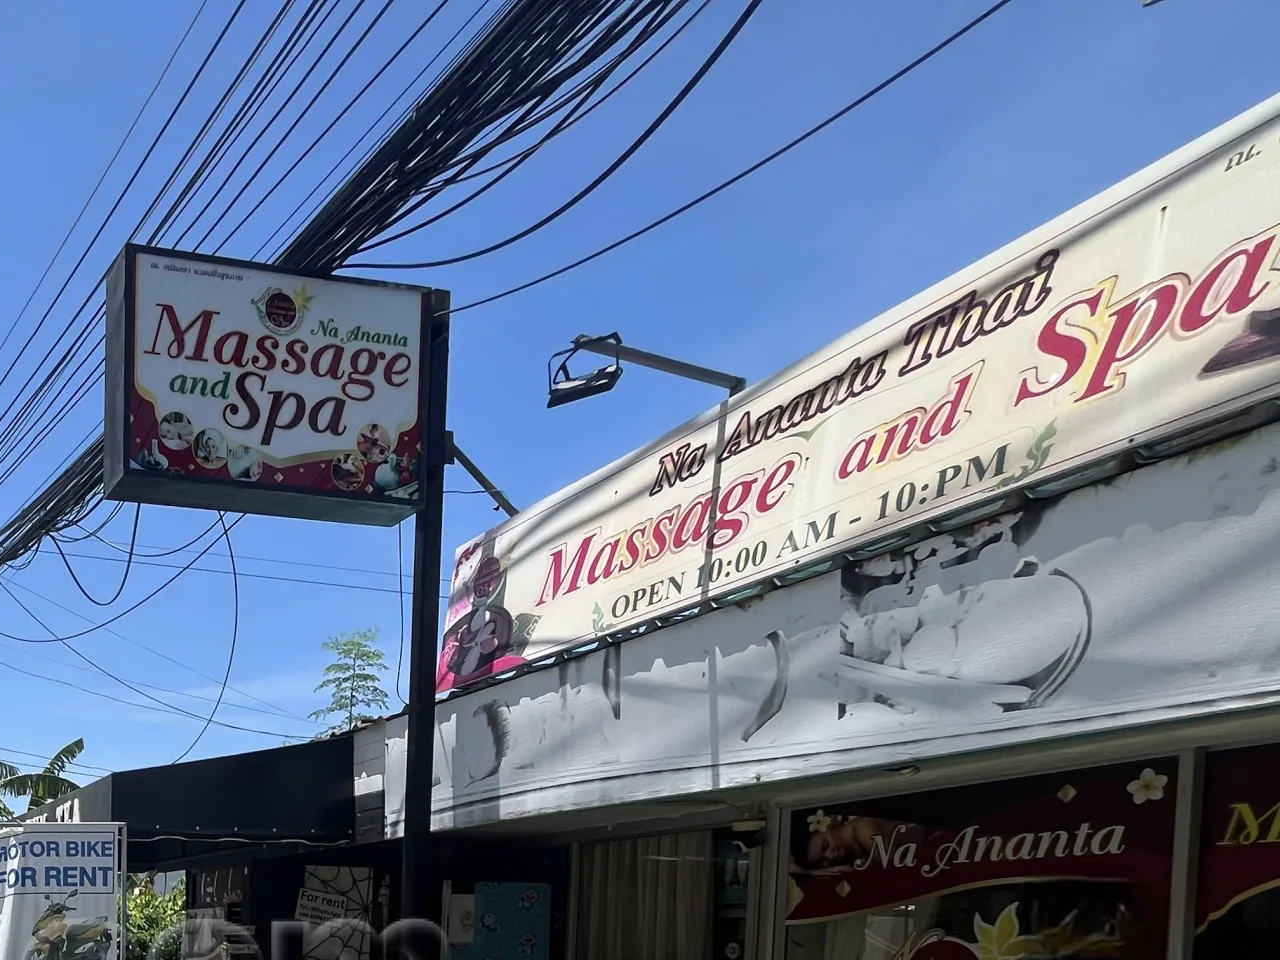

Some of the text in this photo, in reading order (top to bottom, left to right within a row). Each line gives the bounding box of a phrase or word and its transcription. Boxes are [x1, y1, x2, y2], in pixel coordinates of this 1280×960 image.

[143, 303, 412, 402] Massage
[311, 318, 409, 348] Na Ananta
[646, 248, 1061, 498] Na Ananta Thai
[169, 371, 348, 446] and Spa
[534, 233, 1278, 607] Massage and Spa
[610, 573, 685, 621] OPEN
[694, 538, 770, 589] 10:00
[775, 511, 838, 561] AM
[876, 444, 1010, 522] 10:PM
[43, 866, 113, 887] RENT
[65, 840, 113, 857] BIKE
[854, 823, 1126, 878] Na Ananta
[300, 890, 345, 909] For rent
